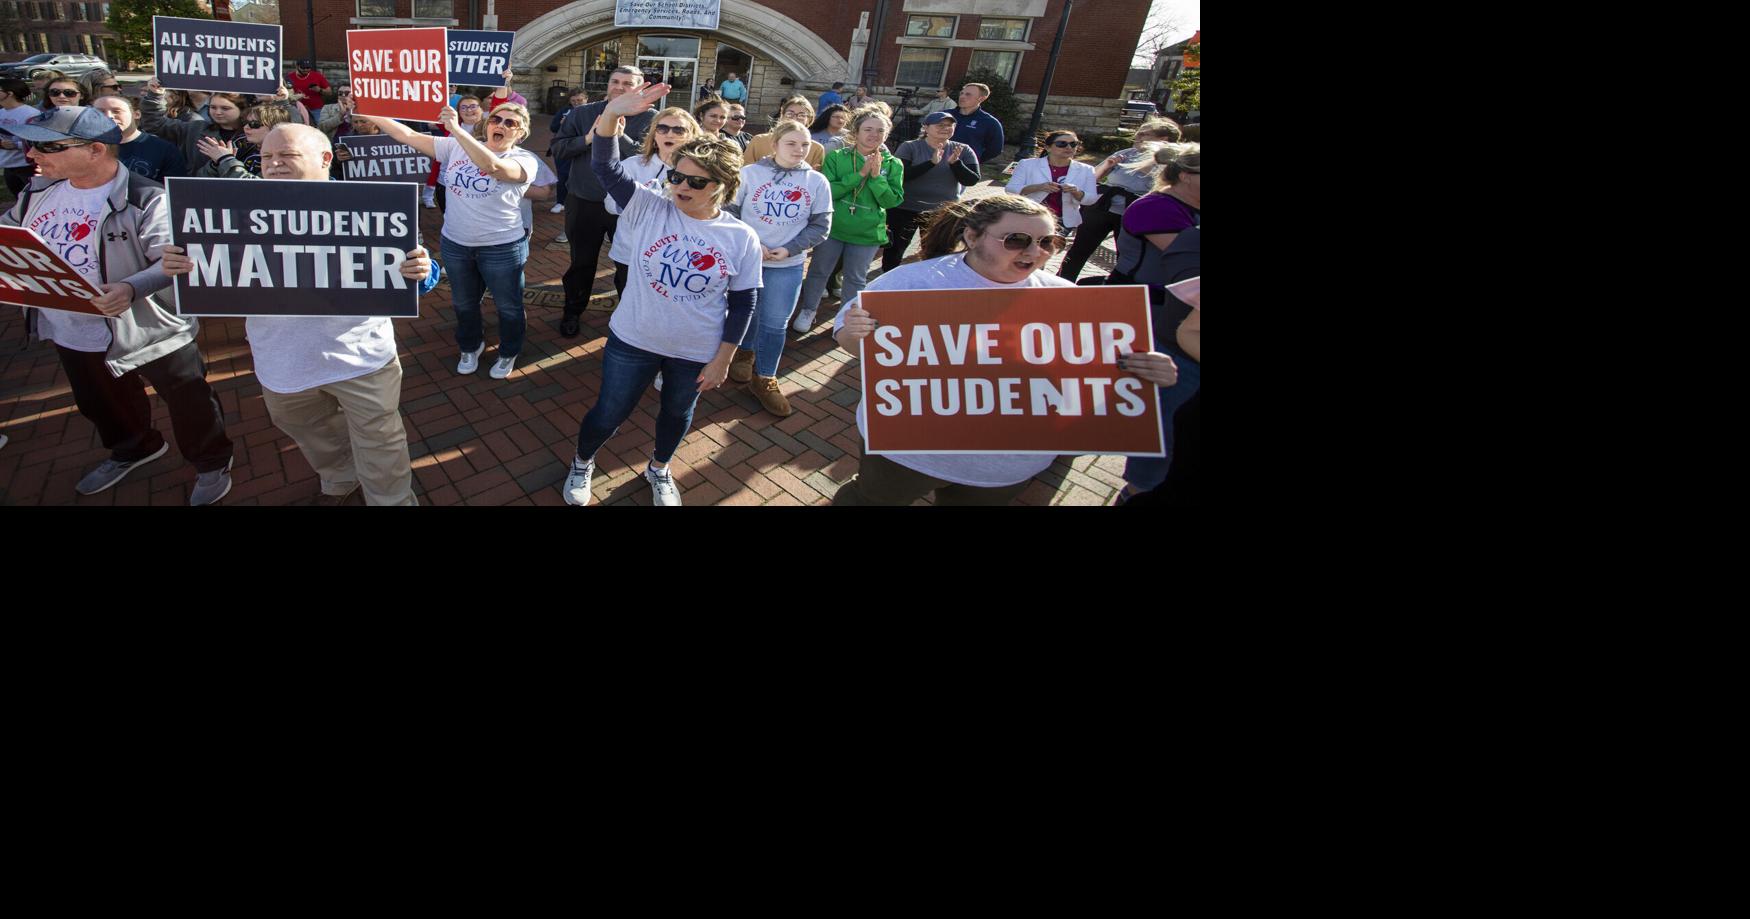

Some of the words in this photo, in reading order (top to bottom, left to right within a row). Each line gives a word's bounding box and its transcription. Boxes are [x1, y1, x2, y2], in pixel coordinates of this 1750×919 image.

[160, 31, 190, 47] ALL
[195, 34, 276, 53] STUDENTS
[449, 40, 509, 53] STUDENTS
[162, 50, 275, 80] MATTER
[352, 49, 394, 73] SAVE
[400, 49, 442, 74] OUR
[447, 54, 506, 75] TTER
[354, 78, 443, 103] STUDENTS
[371, 144, 421, 157] STUDEN
[347, 157, 432, 178] MATTER
[452, 171, 490, 193] NC
[466, 183, 502, 200] STUDE
[62, 207, 84, 217] AND
[763, 201, 801, 219] NC
[182, 208, 239, 234] ALL
[250, 209, 409, 238] STUDENTS
[643, 233, 680, 259] EQUITY
[683, 234, 706, 248] AND
[0, 245, 67, 274] UR
[187, 243, 408, 290] MATTER
[643, 258, 653, 278] FOR
[649, 281, 670, 298] ALL
[672, 284, 720, 303] STUDE
[655, 262, 712, 294] NC
[873, 323, 1002, 367] SAVE
[1020, 322, 1136, 365] OUR
[875, 377, 1146, 417] STUDENTS
